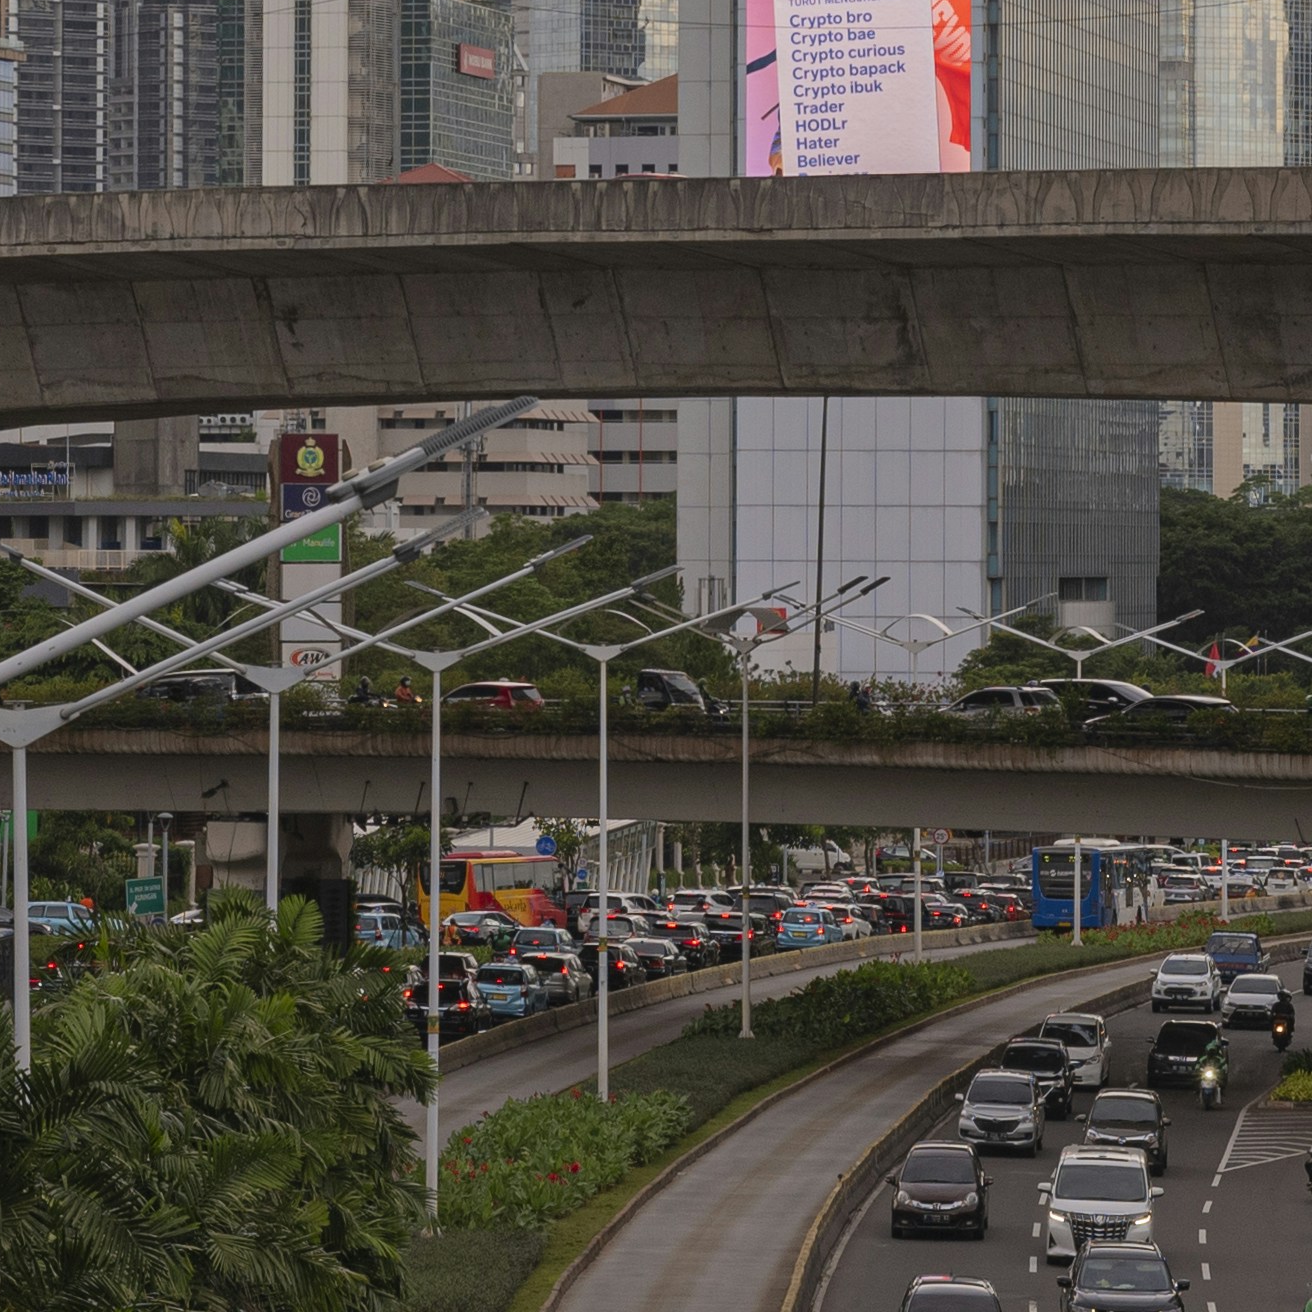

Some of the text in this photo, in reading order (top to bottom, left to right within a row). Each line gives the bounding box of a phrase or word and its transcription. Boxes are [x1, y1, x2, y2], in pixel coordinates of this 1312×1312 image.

[789, 11, 873, 30] Crypto bro
[790, 29, 876, 47] Crypto bae
[791, 44, 906, 65] Crypto curious
[792, 60, 906, 82] Crypto bapack
[793, 79, 884, 100] Crypto ibuk
[794, 100, 845, 115] Trader
[795, 117, 848, 133] HODLr
[796, 136, 840, 150] Hater
[797, 152, 861, 168] Believer
[302, 537, 335, 549] Manulife
